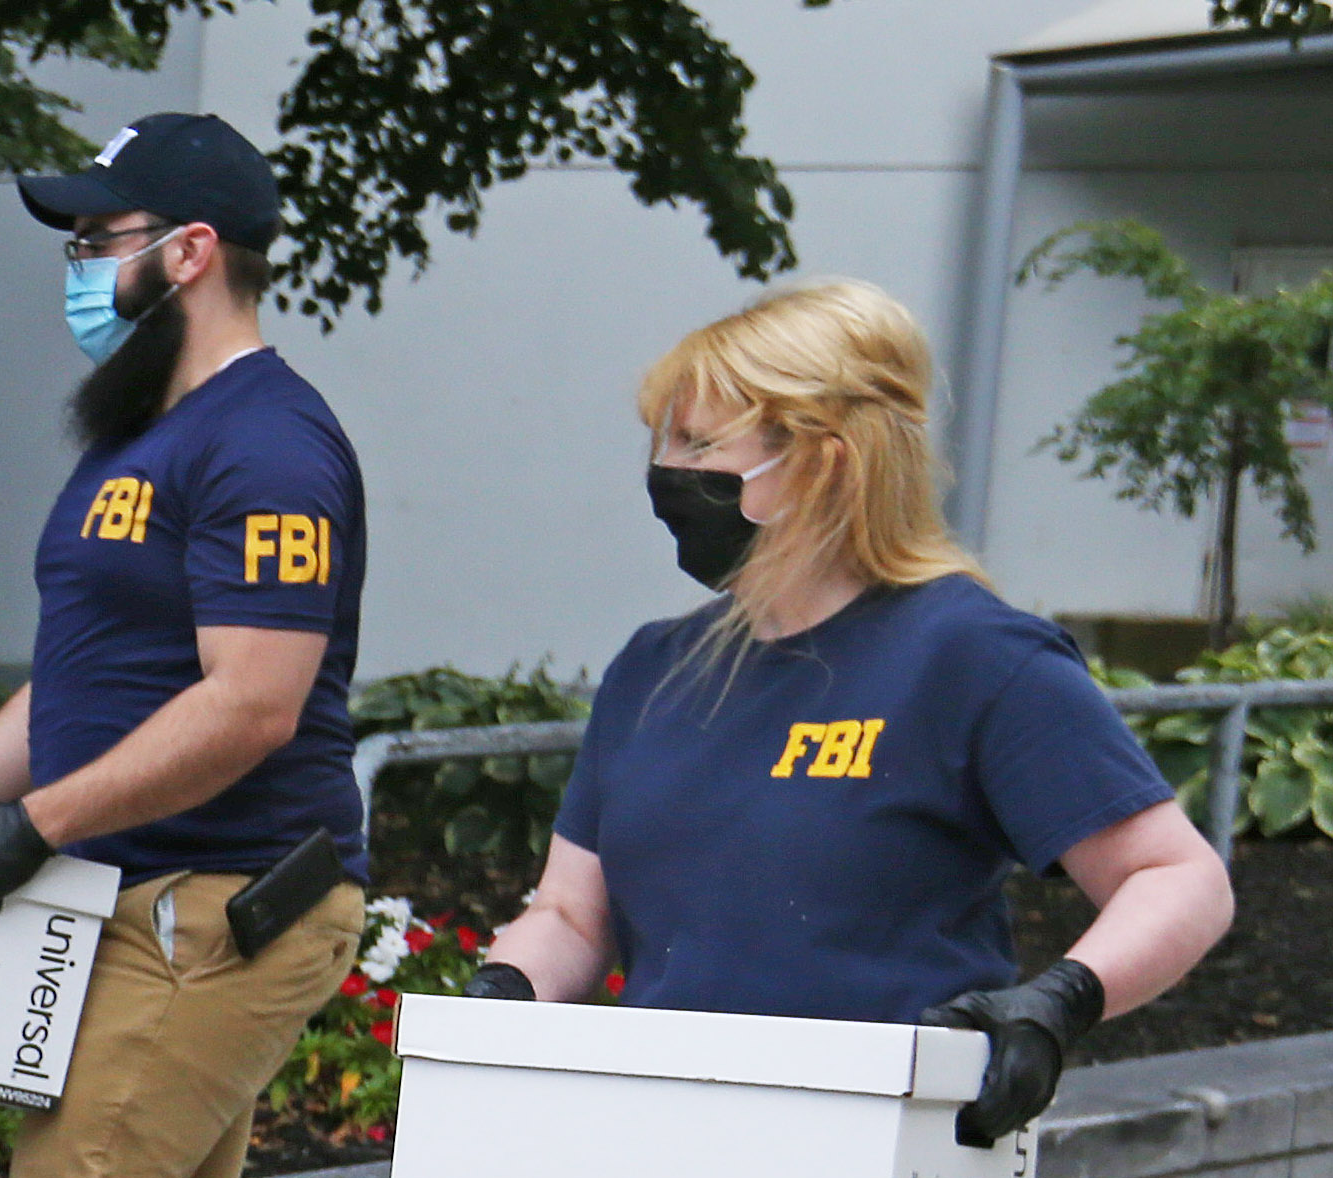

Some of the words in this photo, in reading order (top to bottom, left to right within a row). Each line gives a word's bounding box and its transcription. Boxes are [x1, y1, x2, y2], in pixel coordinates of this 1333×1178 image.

[80, 476, 155, 543] FBI
[244, 513, 331, 586] FBI
[770, 718, 885, 778] FBI
[12, 913, 76, 1079] universal
